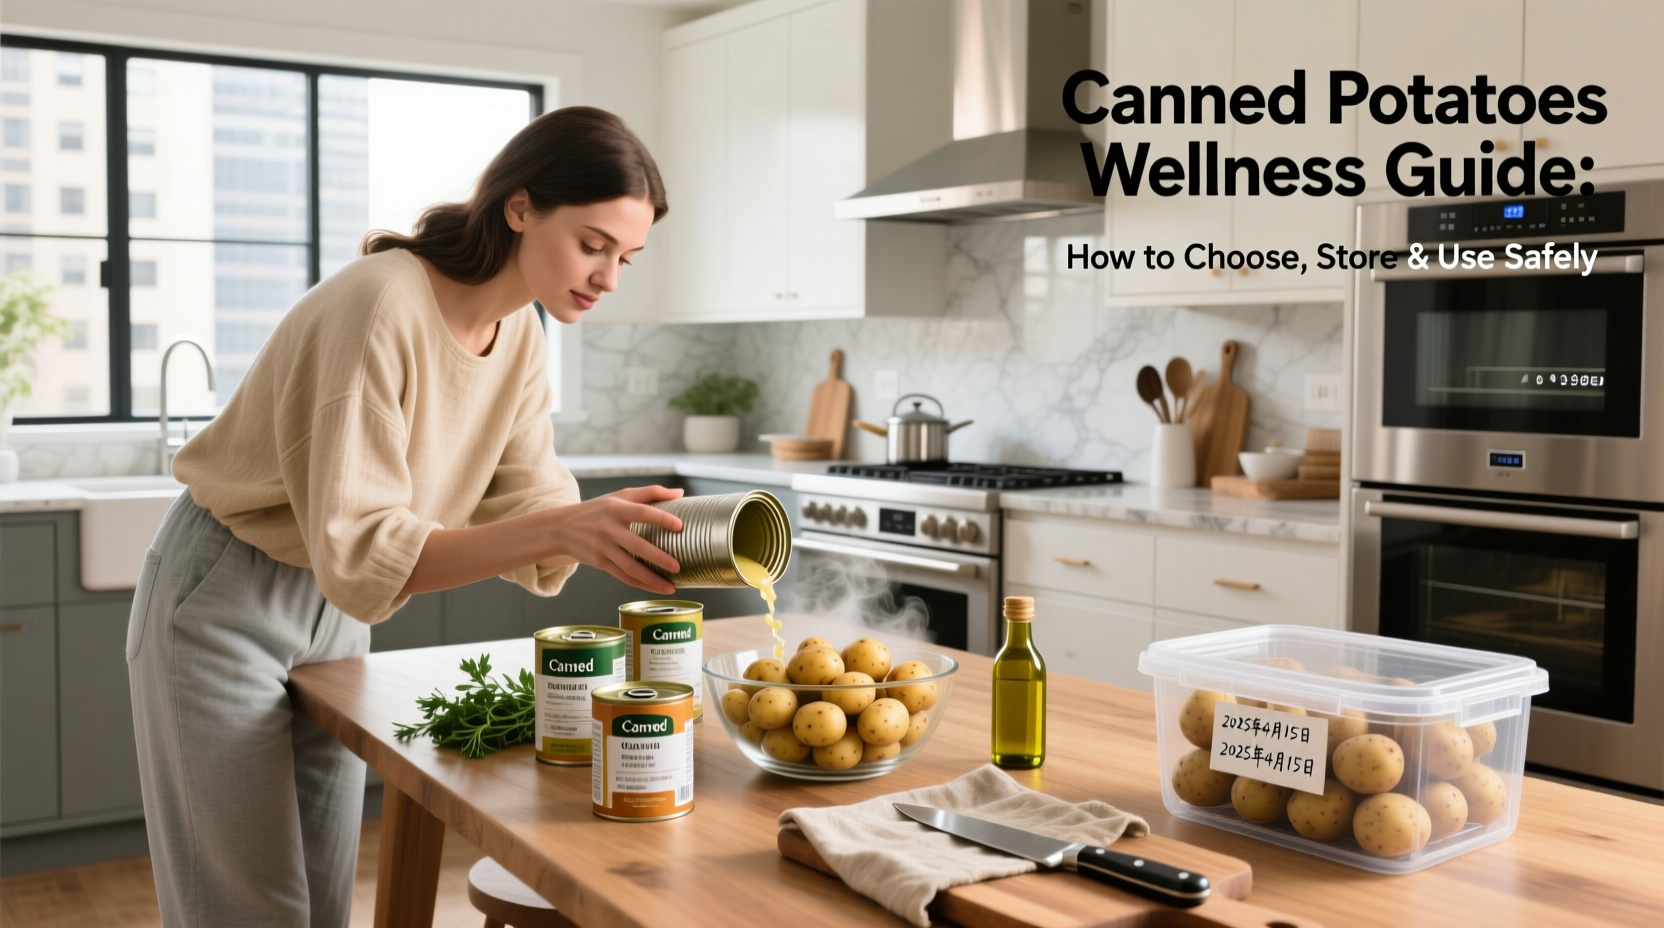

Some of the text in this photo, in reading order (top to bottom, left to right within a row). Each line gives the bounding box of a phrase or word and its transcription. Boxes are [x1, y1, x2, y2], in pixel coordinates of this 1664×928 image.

[1222, 715, 1309, 743] 2025年4月15日
[1220, 742, 1314, 778] 2025年4月15日
